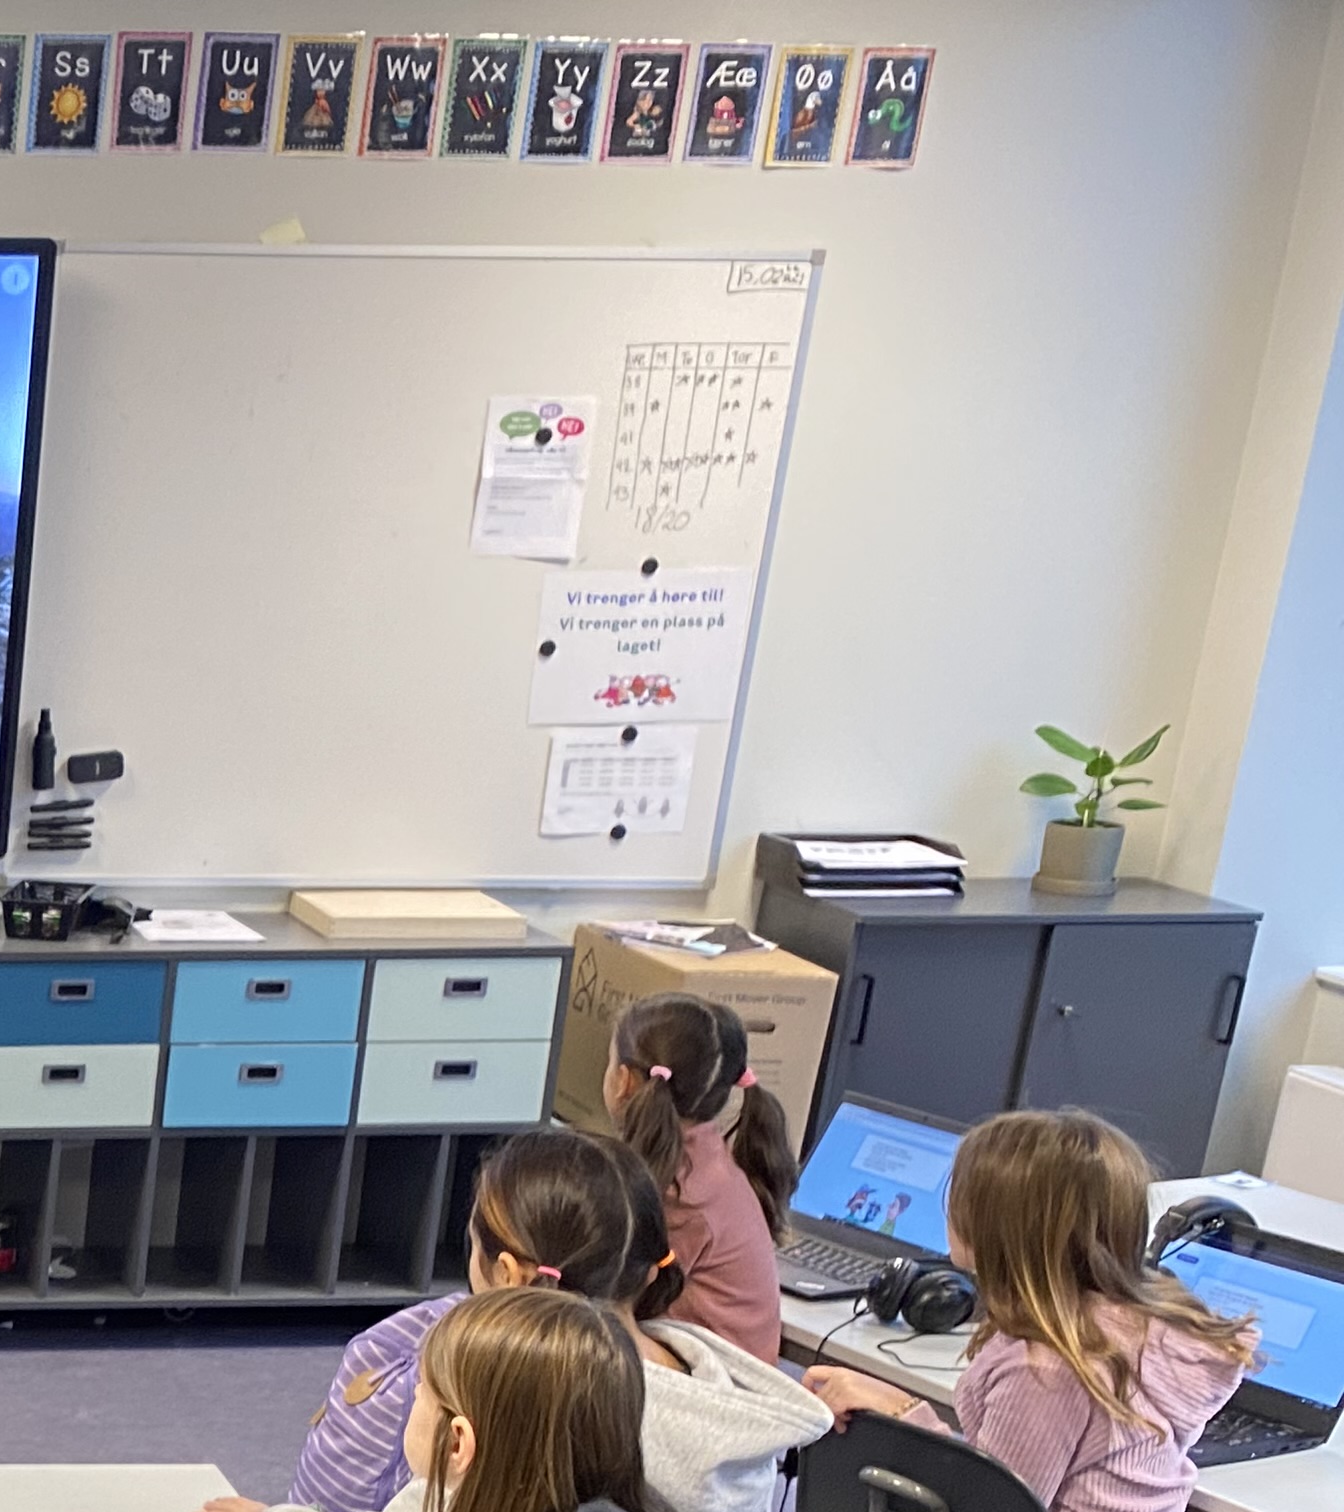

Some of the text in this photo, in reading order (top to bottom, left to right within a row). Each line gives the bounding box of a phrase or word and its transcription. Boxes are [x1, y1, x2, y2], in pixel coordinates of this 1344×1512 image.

[54, 50, 90, 77] Ss
[137, 49, 174, 77] Tt
[221, 49, 258, 76] Uu
[305, 51, 345, 79] Vv
[385, 53, 432, 82] Ww
[469, 54, 508, 82] Xx
[554, 56, 591, 92] Yy
[630, 60, 669, 88] Zz
[795, 61, 834, 92] Øø
[875, 59, 915, 91] Åå
[567, 591, 583, 606] Vi
[586, 590, 646, 608] trenger
[559, 618, 576, 632] Vi
[578, 617, 638, 633] trenger
[663, 616, 704, 632] plass
[707, 614, 726, 632] på
